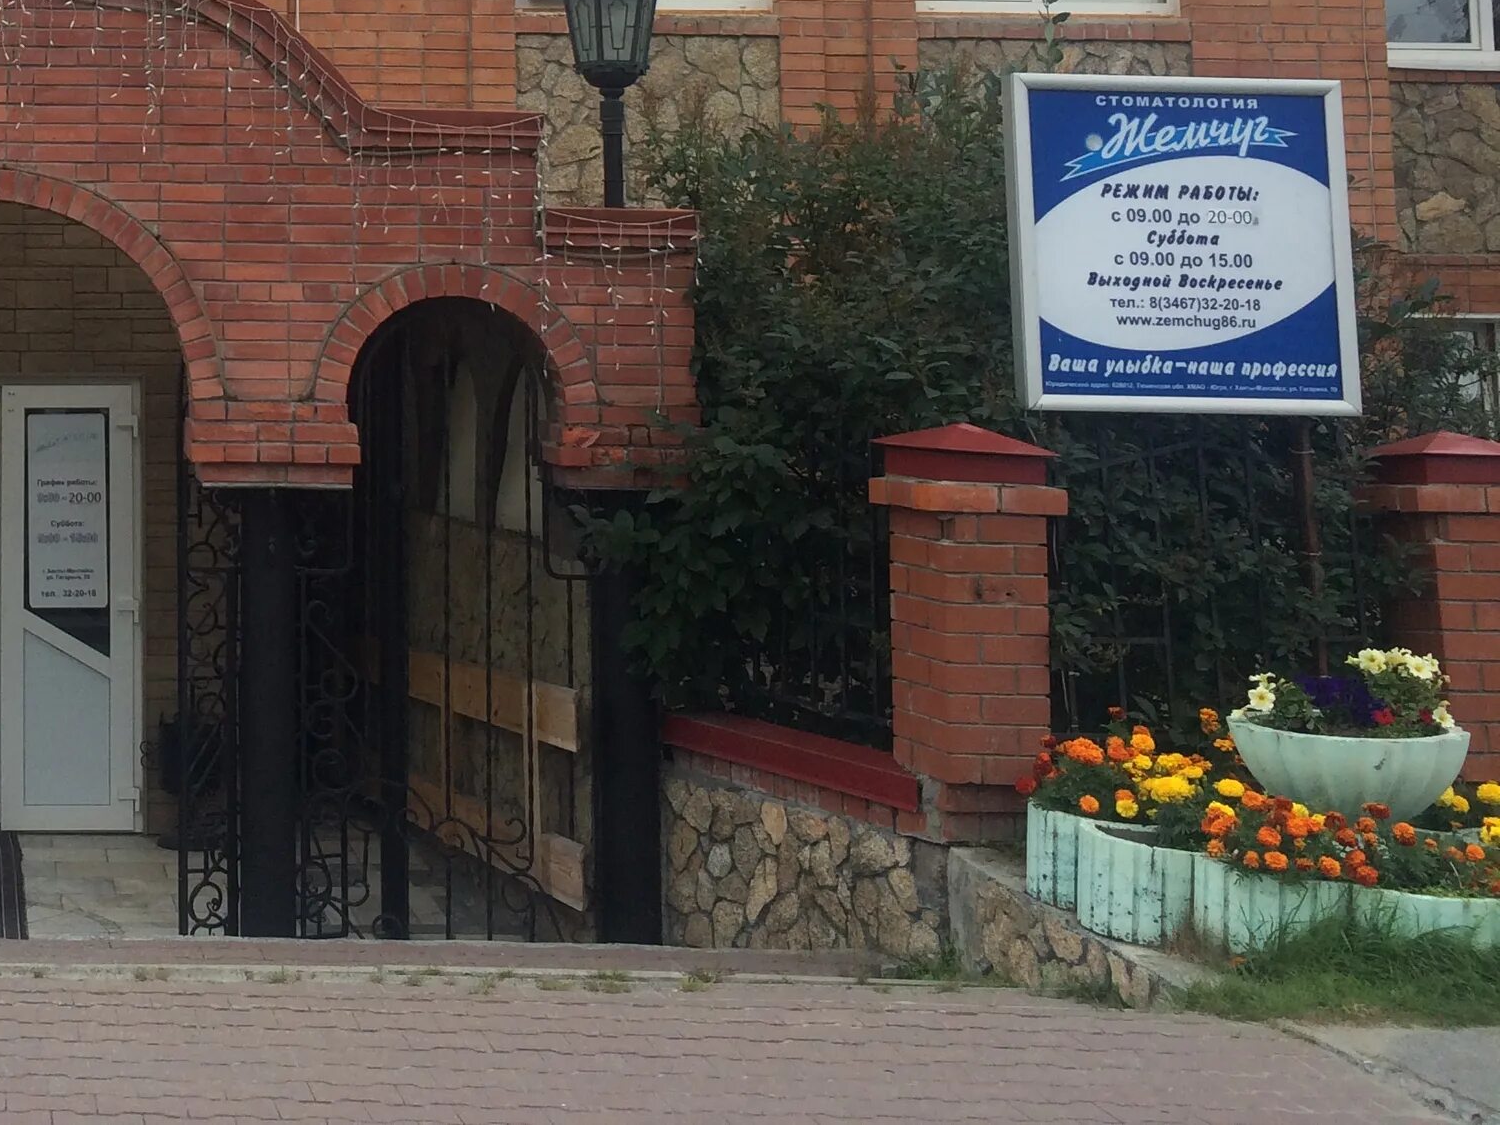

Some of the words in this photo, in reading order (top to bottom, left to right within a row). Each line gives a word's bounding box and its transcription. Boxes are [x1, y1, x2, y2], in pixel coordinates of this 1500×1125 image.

[1095, 94, 1259, 110] СТОМАТОЛОГИЯ
[1100, 112, 1269, 158] Жемчуг
[1100, 182, 1170, 200] РЕЖИМ
[1177, 184, 1260, 202] РАБОТЫ:
[1111, 211, 1122, 222] с
[1126, 208, 1173, 224] 09.00
[1177, 212, 1201, 226] до
[1207, 210, 1253, 225] 20-00
[1146, 229, 1220, 248] Суббота
[1113, 254, 1124, 265] с
[1129, 251, 1175, 266] 09.00
[1179, 255, 1203, 269] до
[1208, 253, 1254, 268] 15.00
[1087, 271, 1172, 292] Выходной
[1178, 273, 1284, 292] Воскресенье
[1109, 297, 1145, 309] тел.:
[1149, 296, 1262, 313] 8(3467)32-20-18
[1116, 315, 1257, 331] www.zemchug86.ru
[1047, 353, 1099, 373] Ваша
[1240, 360, 1338, 381] профессия
[68, 491, 103, 504] 20-00
[62, 588, 97, 597] 32-20-18
